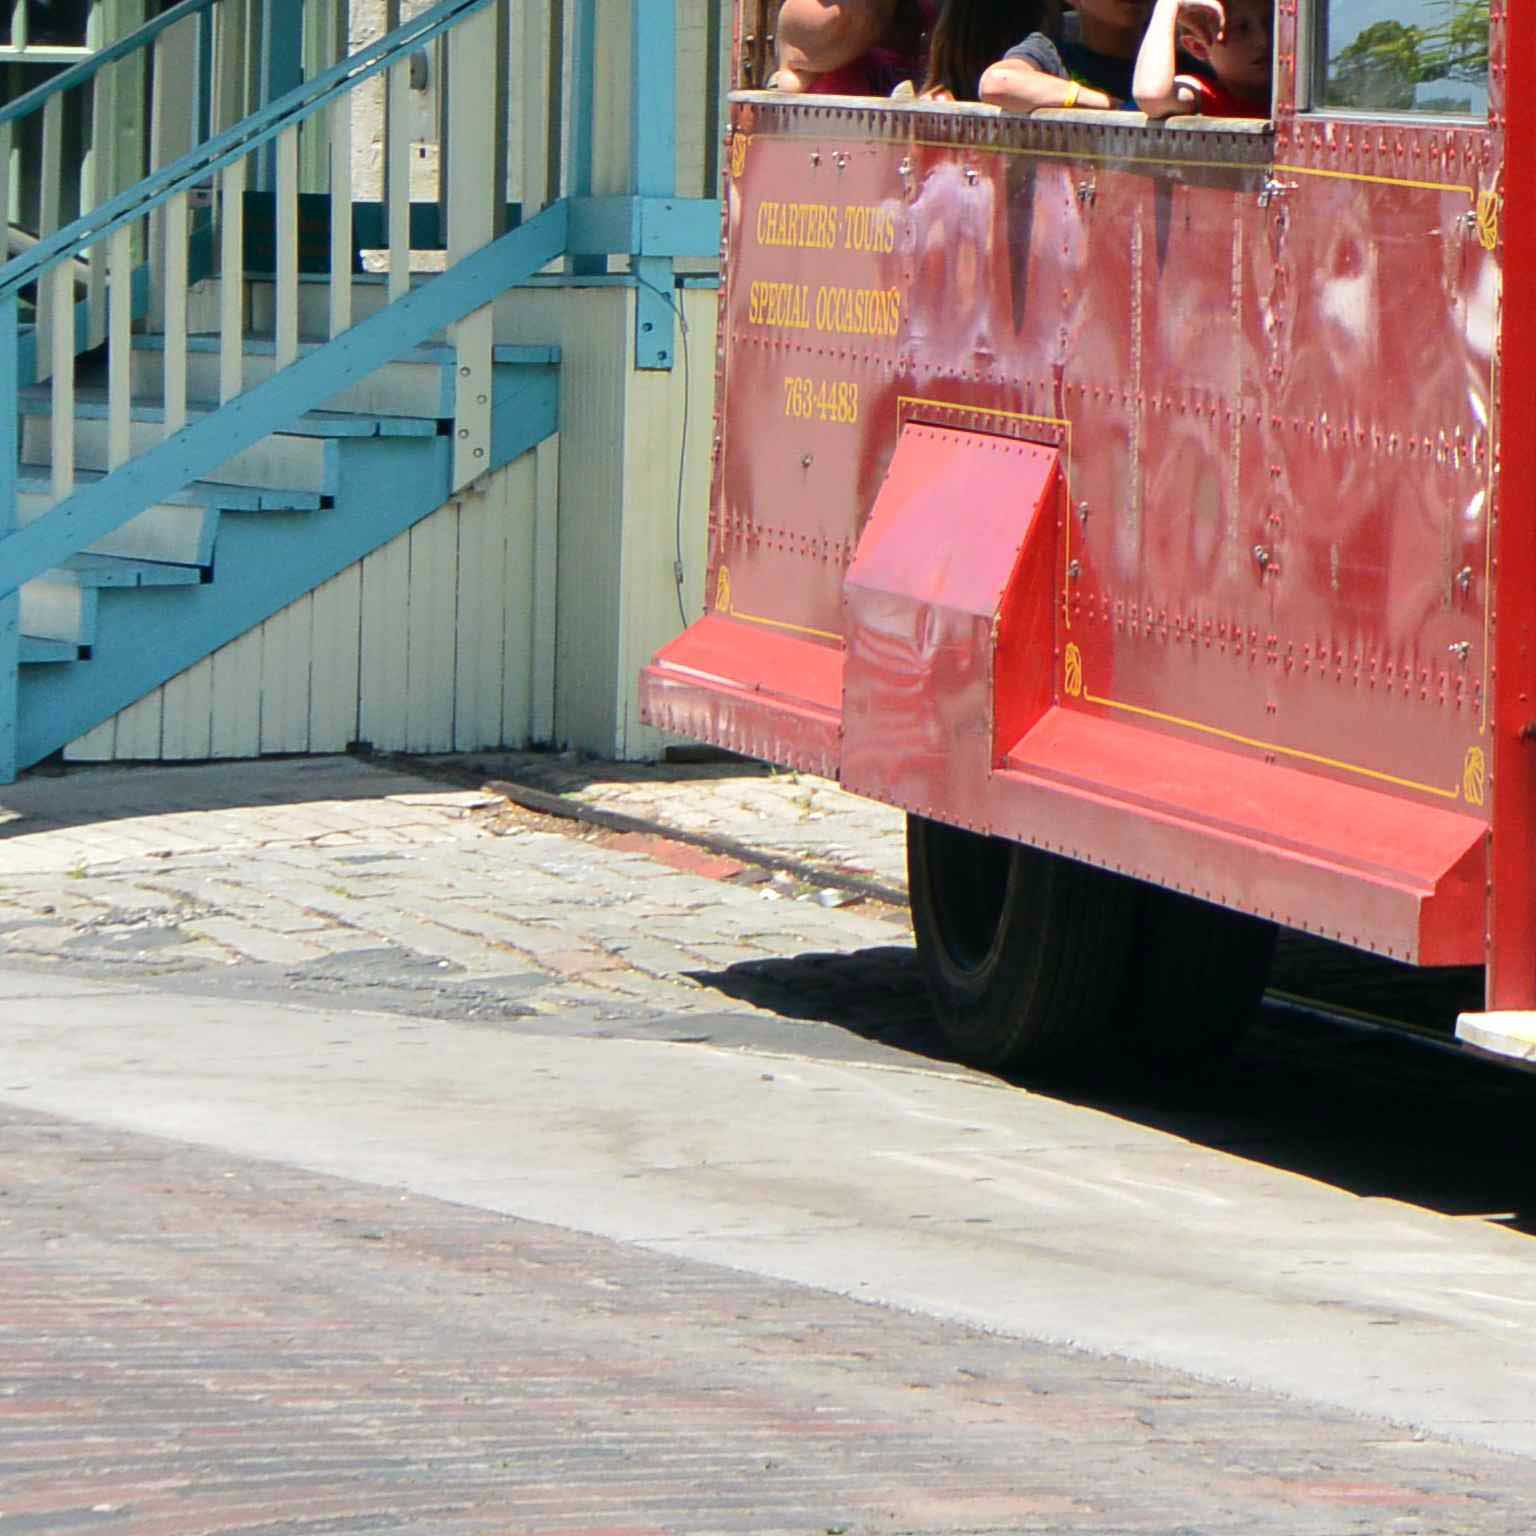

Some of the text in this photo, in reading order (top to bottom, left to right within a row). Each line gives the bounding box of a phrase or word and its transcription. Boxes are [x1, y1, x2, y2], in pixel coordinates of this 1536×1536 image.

[757, 202, 896, 254] CHARTERS TOURS
[749, 280, 900, 337] SPECIAL OCCASIONS
